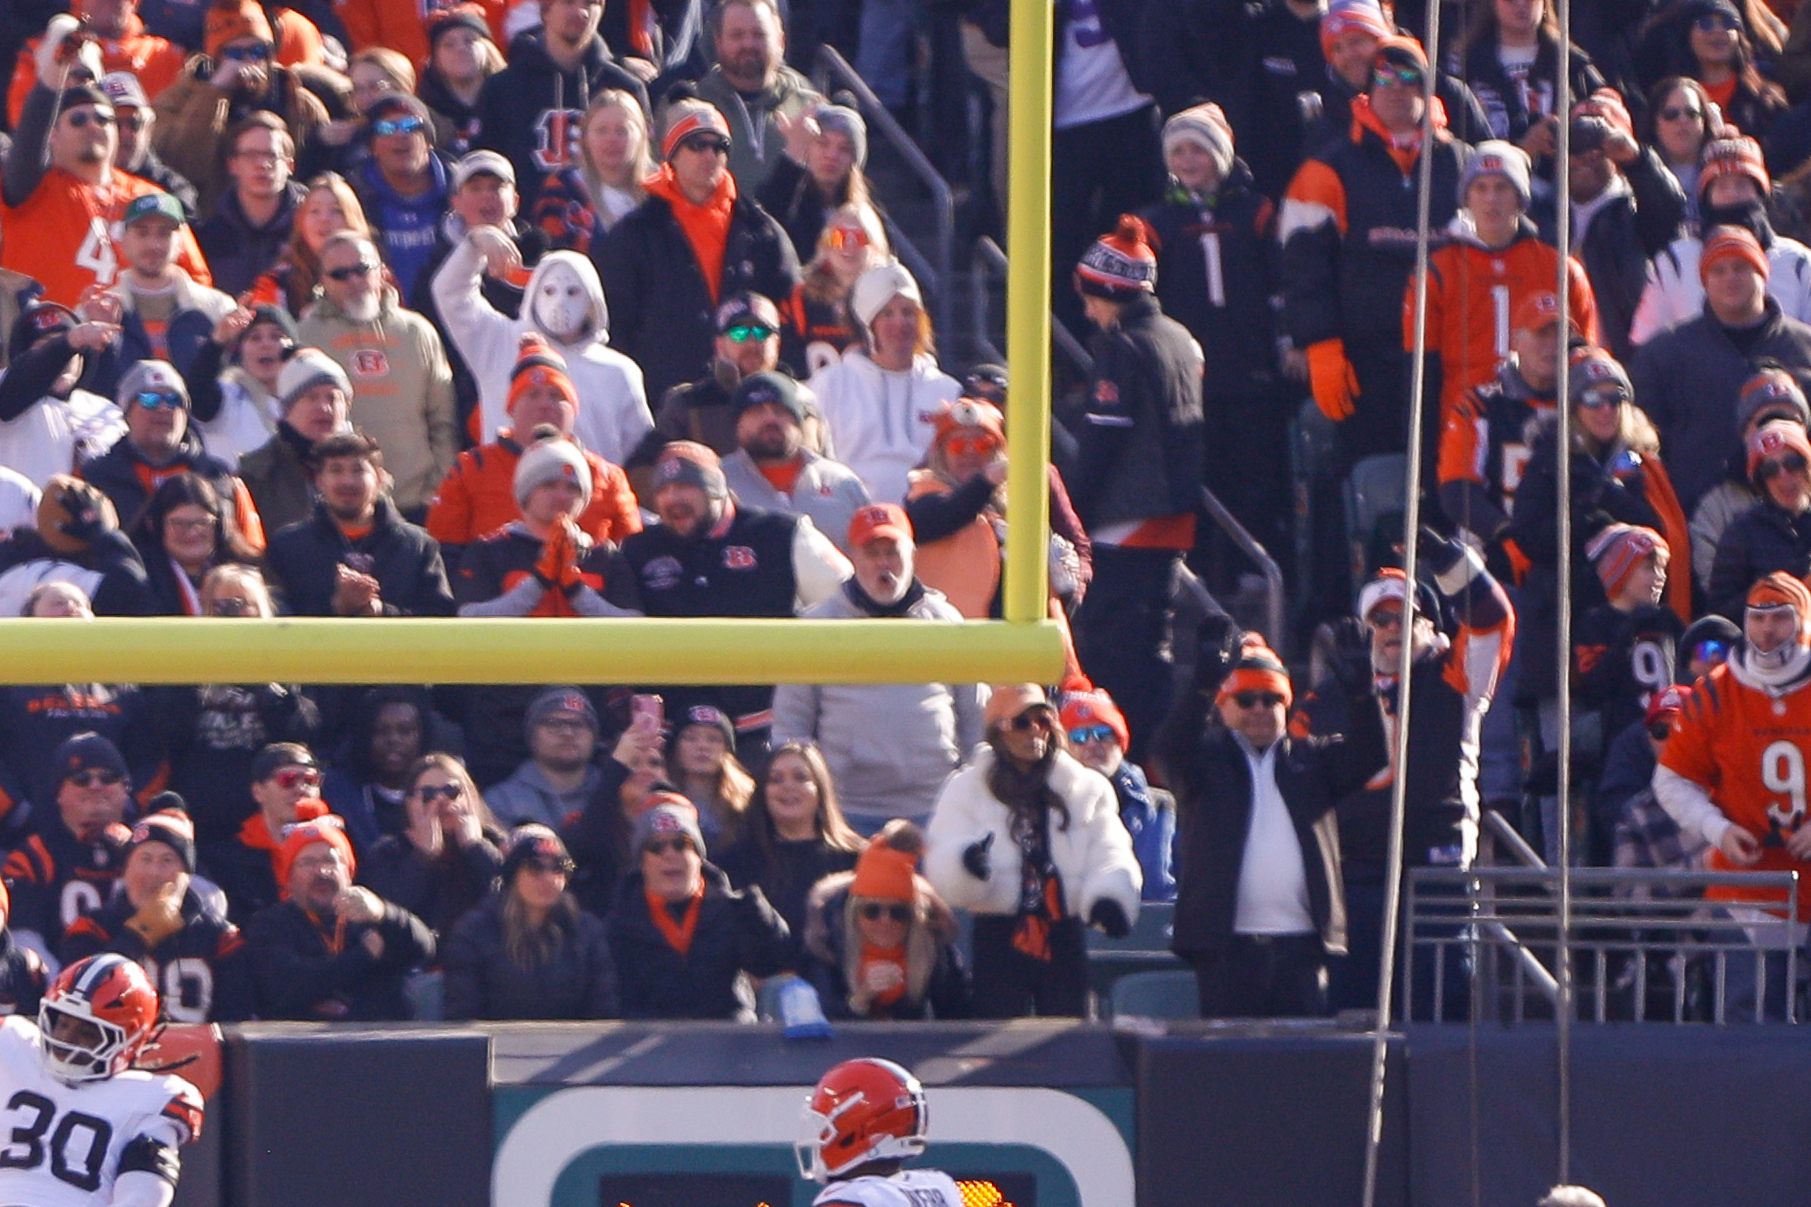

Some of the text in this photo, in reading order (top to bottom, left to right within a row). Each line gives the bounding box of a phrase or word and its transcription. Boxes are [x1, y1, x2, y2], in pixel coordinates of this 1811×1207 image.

[1196, 232, 1222, 307] 1
[1490, 284, 1507, 358] 1
[1758, 739, 1803, 827] 9
